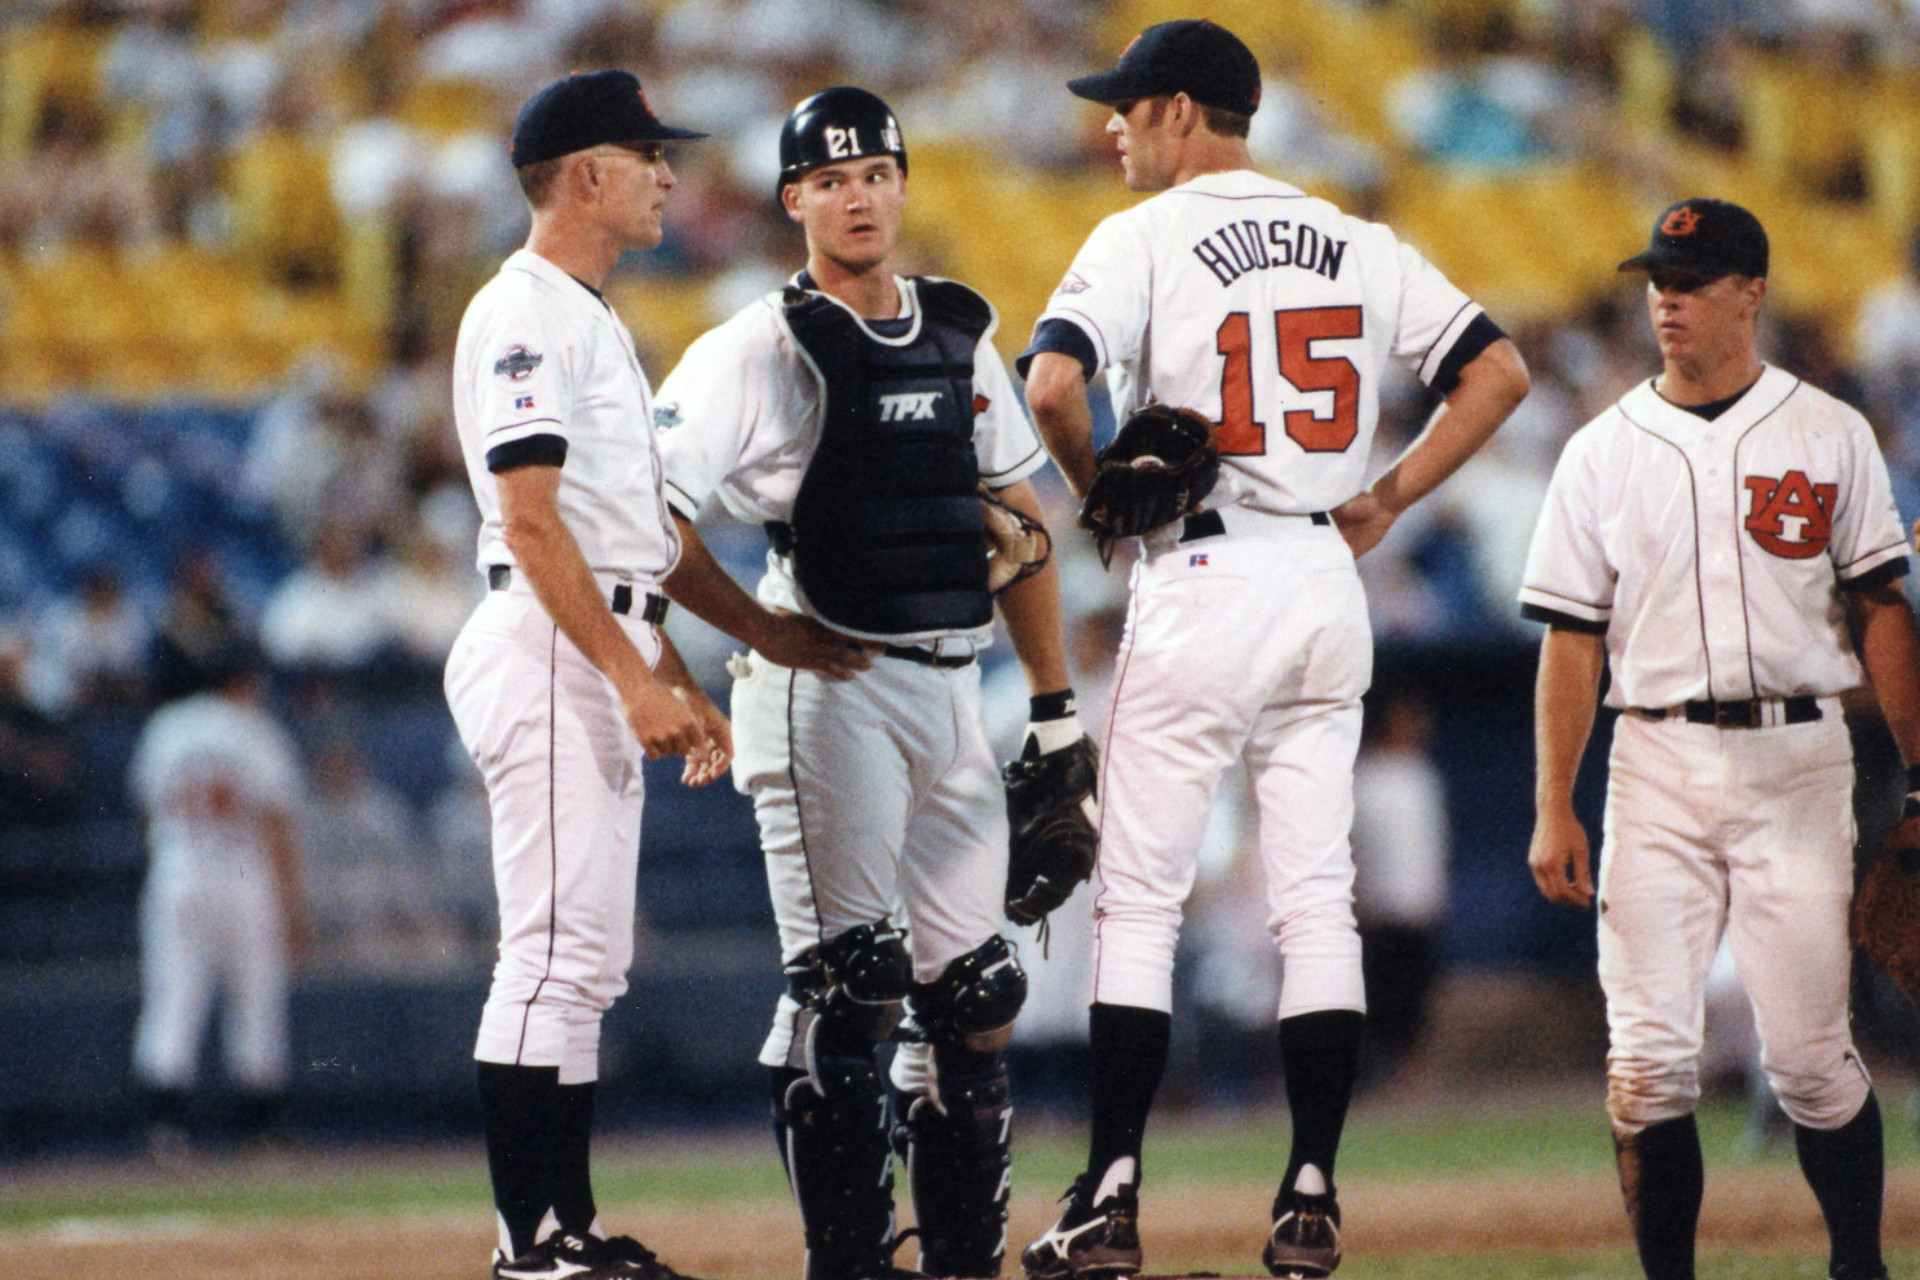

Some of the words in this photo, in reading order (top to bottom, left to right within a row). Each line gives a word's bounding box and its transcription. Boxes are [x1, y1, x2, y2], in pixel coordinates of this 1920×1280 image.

[824, 126, 862, 158] 21
[1193, 219, 1348, 288] HUDSON
[1214, 304, 1363, 456] 15
[879, 391, 943, 422] TPX
